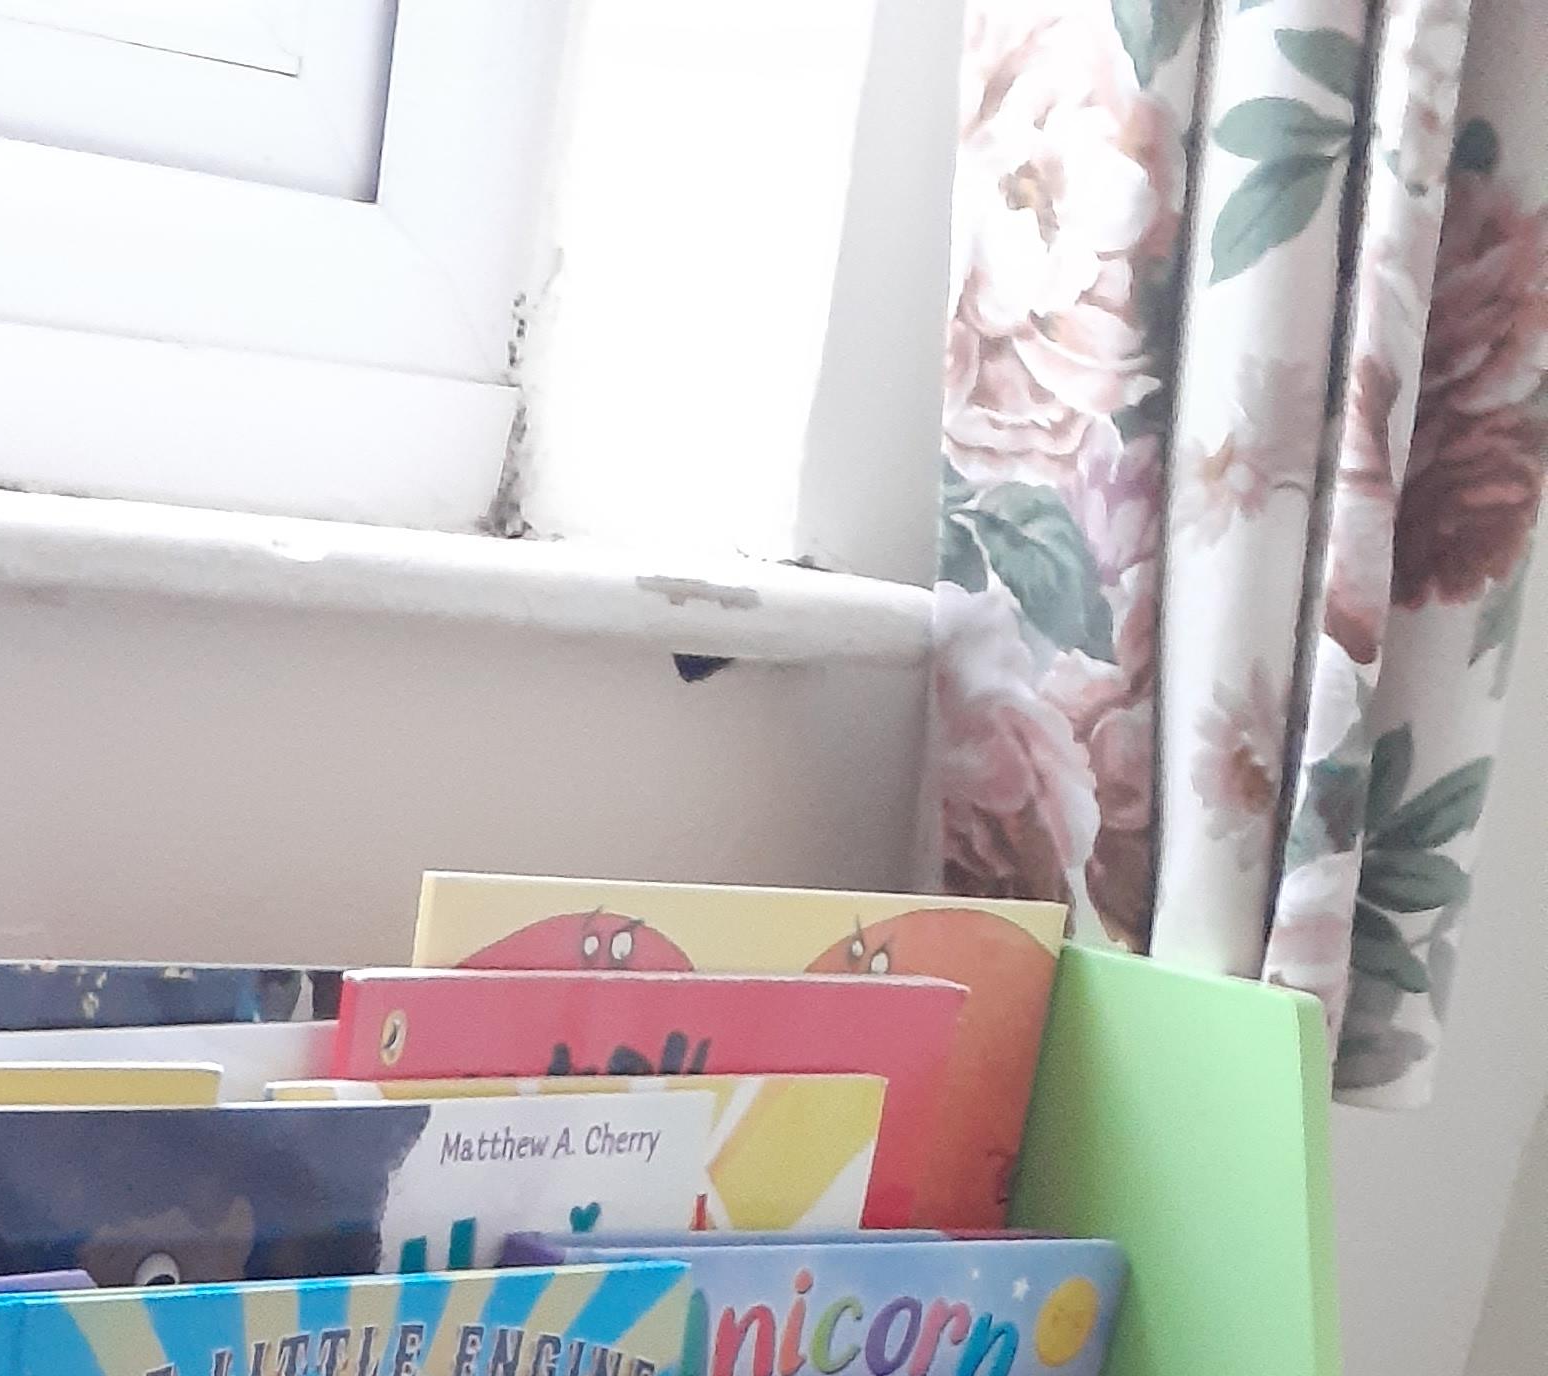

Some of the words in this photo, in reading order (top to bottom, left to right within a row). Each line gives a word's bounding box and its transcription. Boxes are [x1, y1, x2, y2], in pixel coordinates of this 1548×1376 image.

[439, 1126, 549, 1165] Matthew
[553, 1127, 576, 1161] A.
[584, 1122, 661, 1163] Cherry
